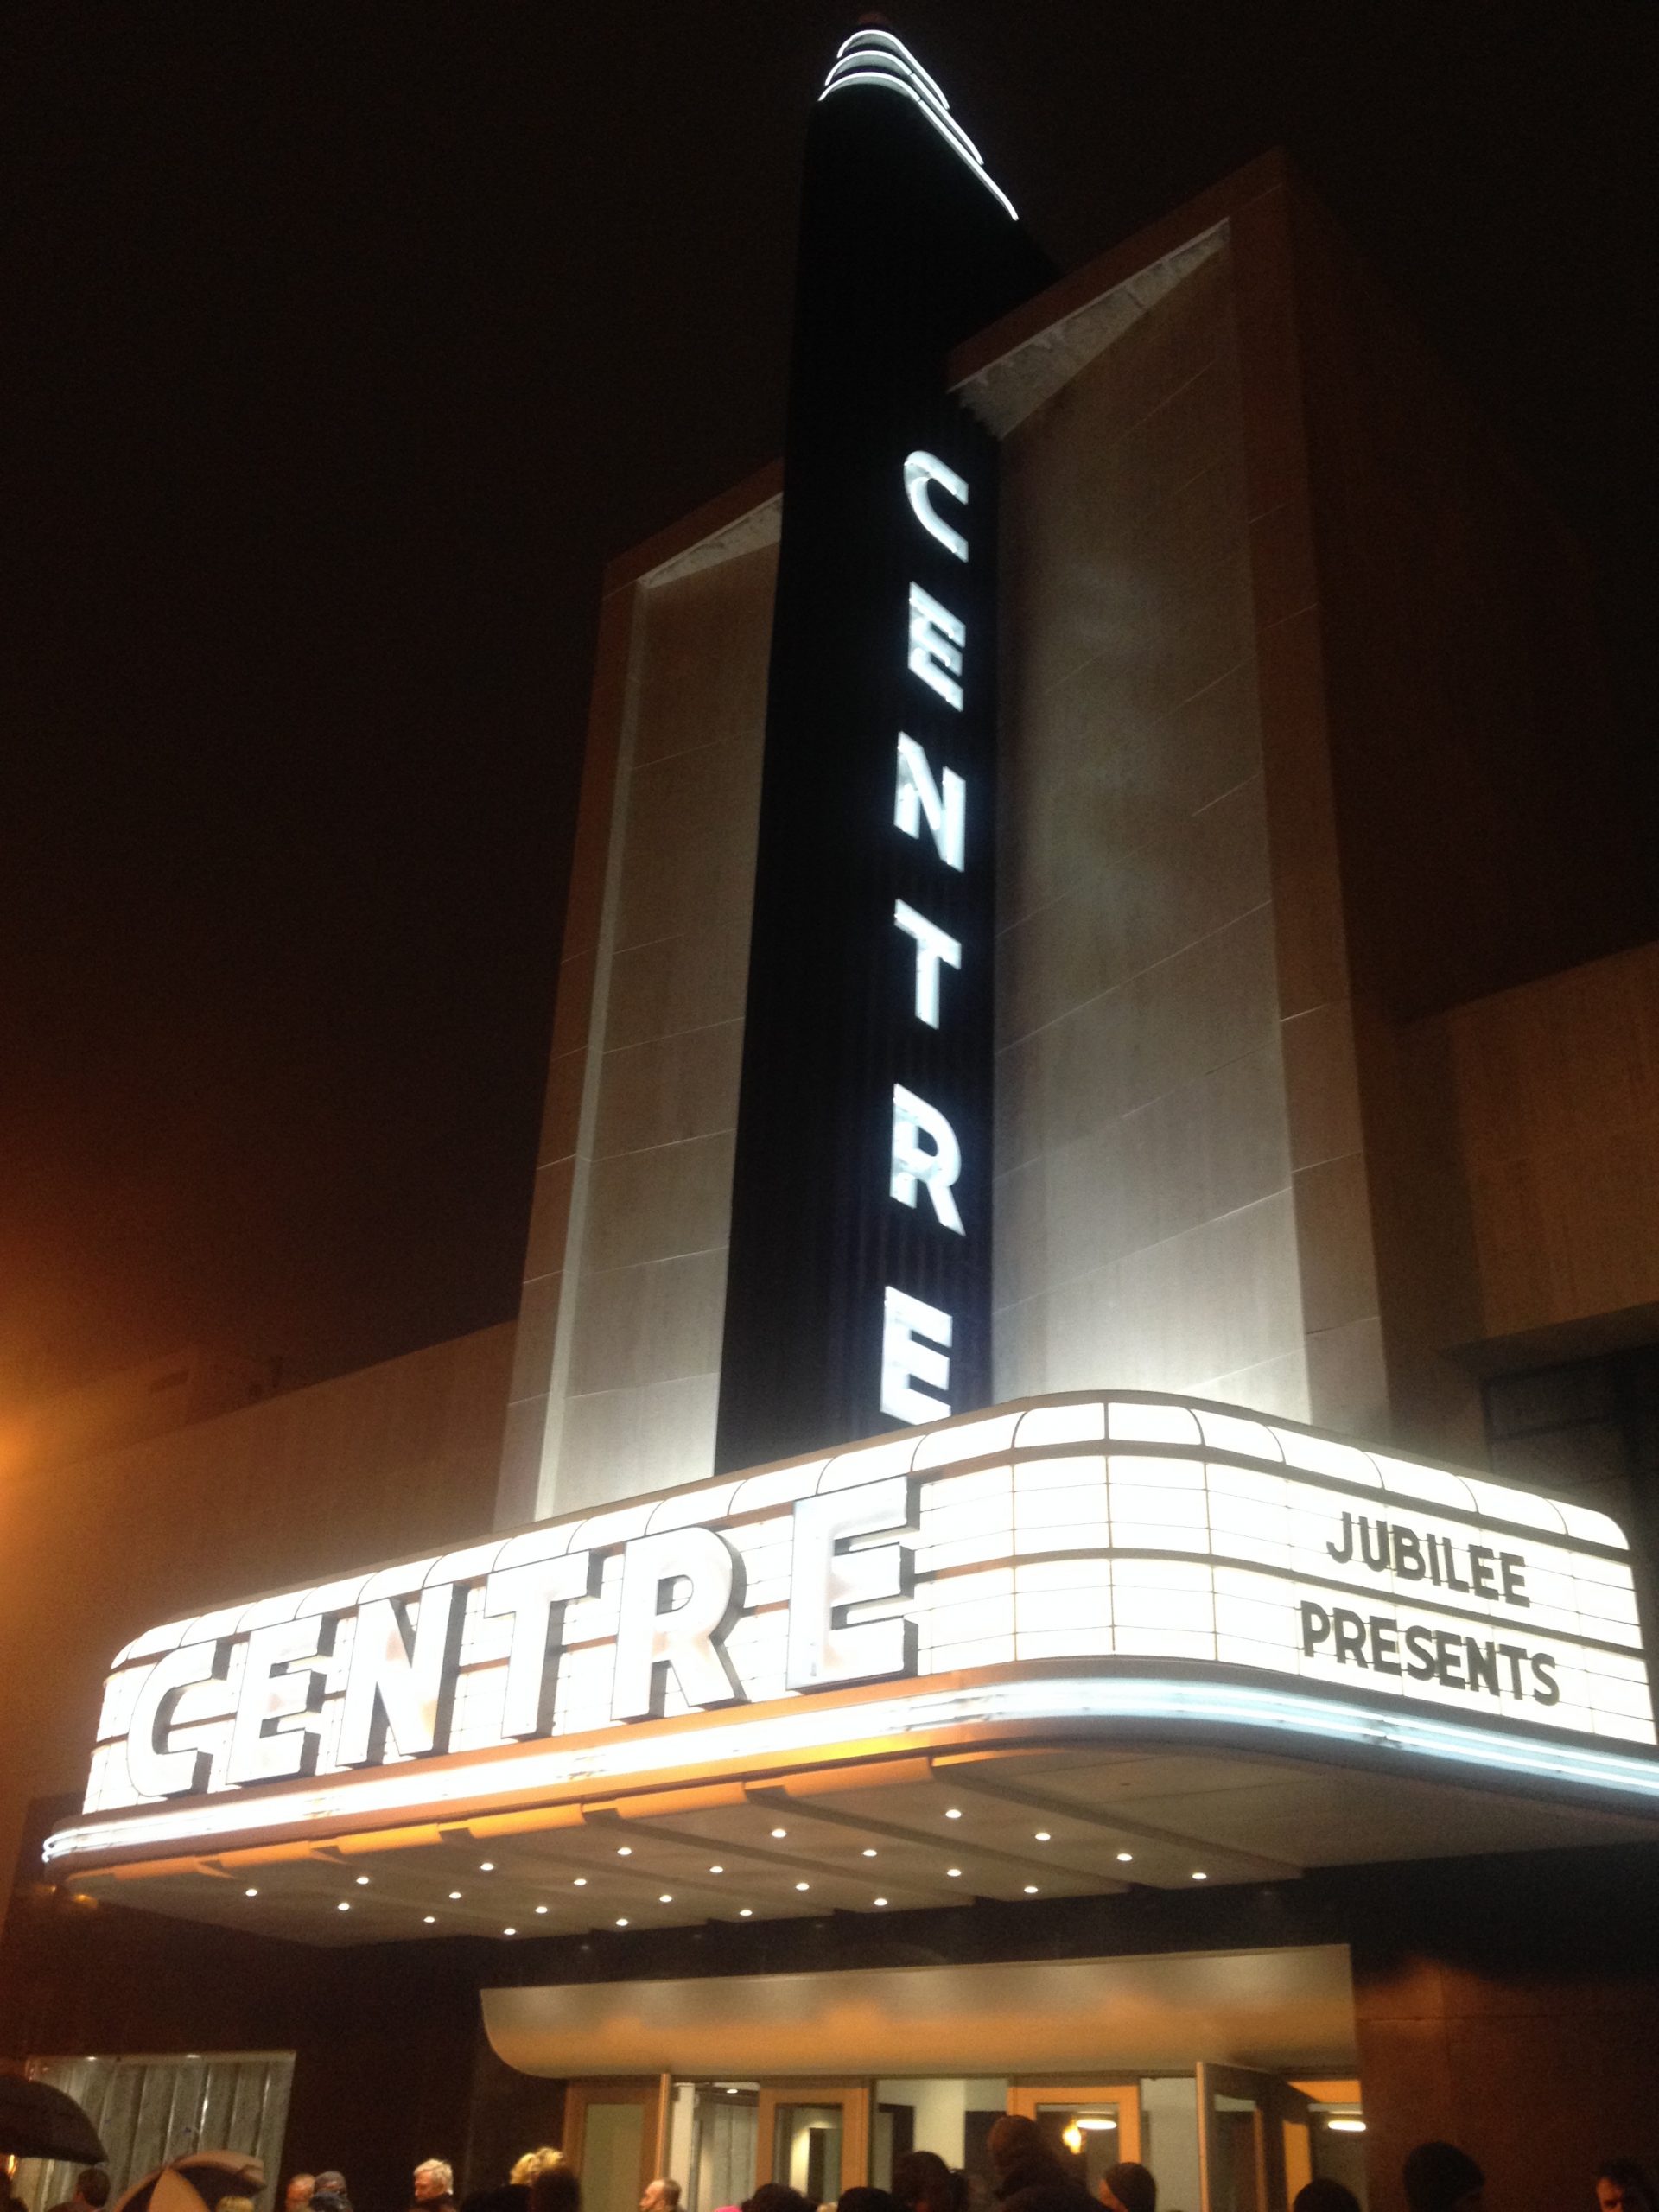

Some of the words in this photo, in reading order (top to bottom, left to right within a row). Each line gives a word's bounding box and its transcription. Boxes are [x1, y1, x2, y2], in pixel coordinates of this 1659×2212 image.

[880, 450, 969, 1426] CENTRE
[127, 1476, 919, 1798] CENTRE
[1300, 1600, 1560, 1706] PRESENTS
[1326, 1511, 1530, 1608] JUBILEE
